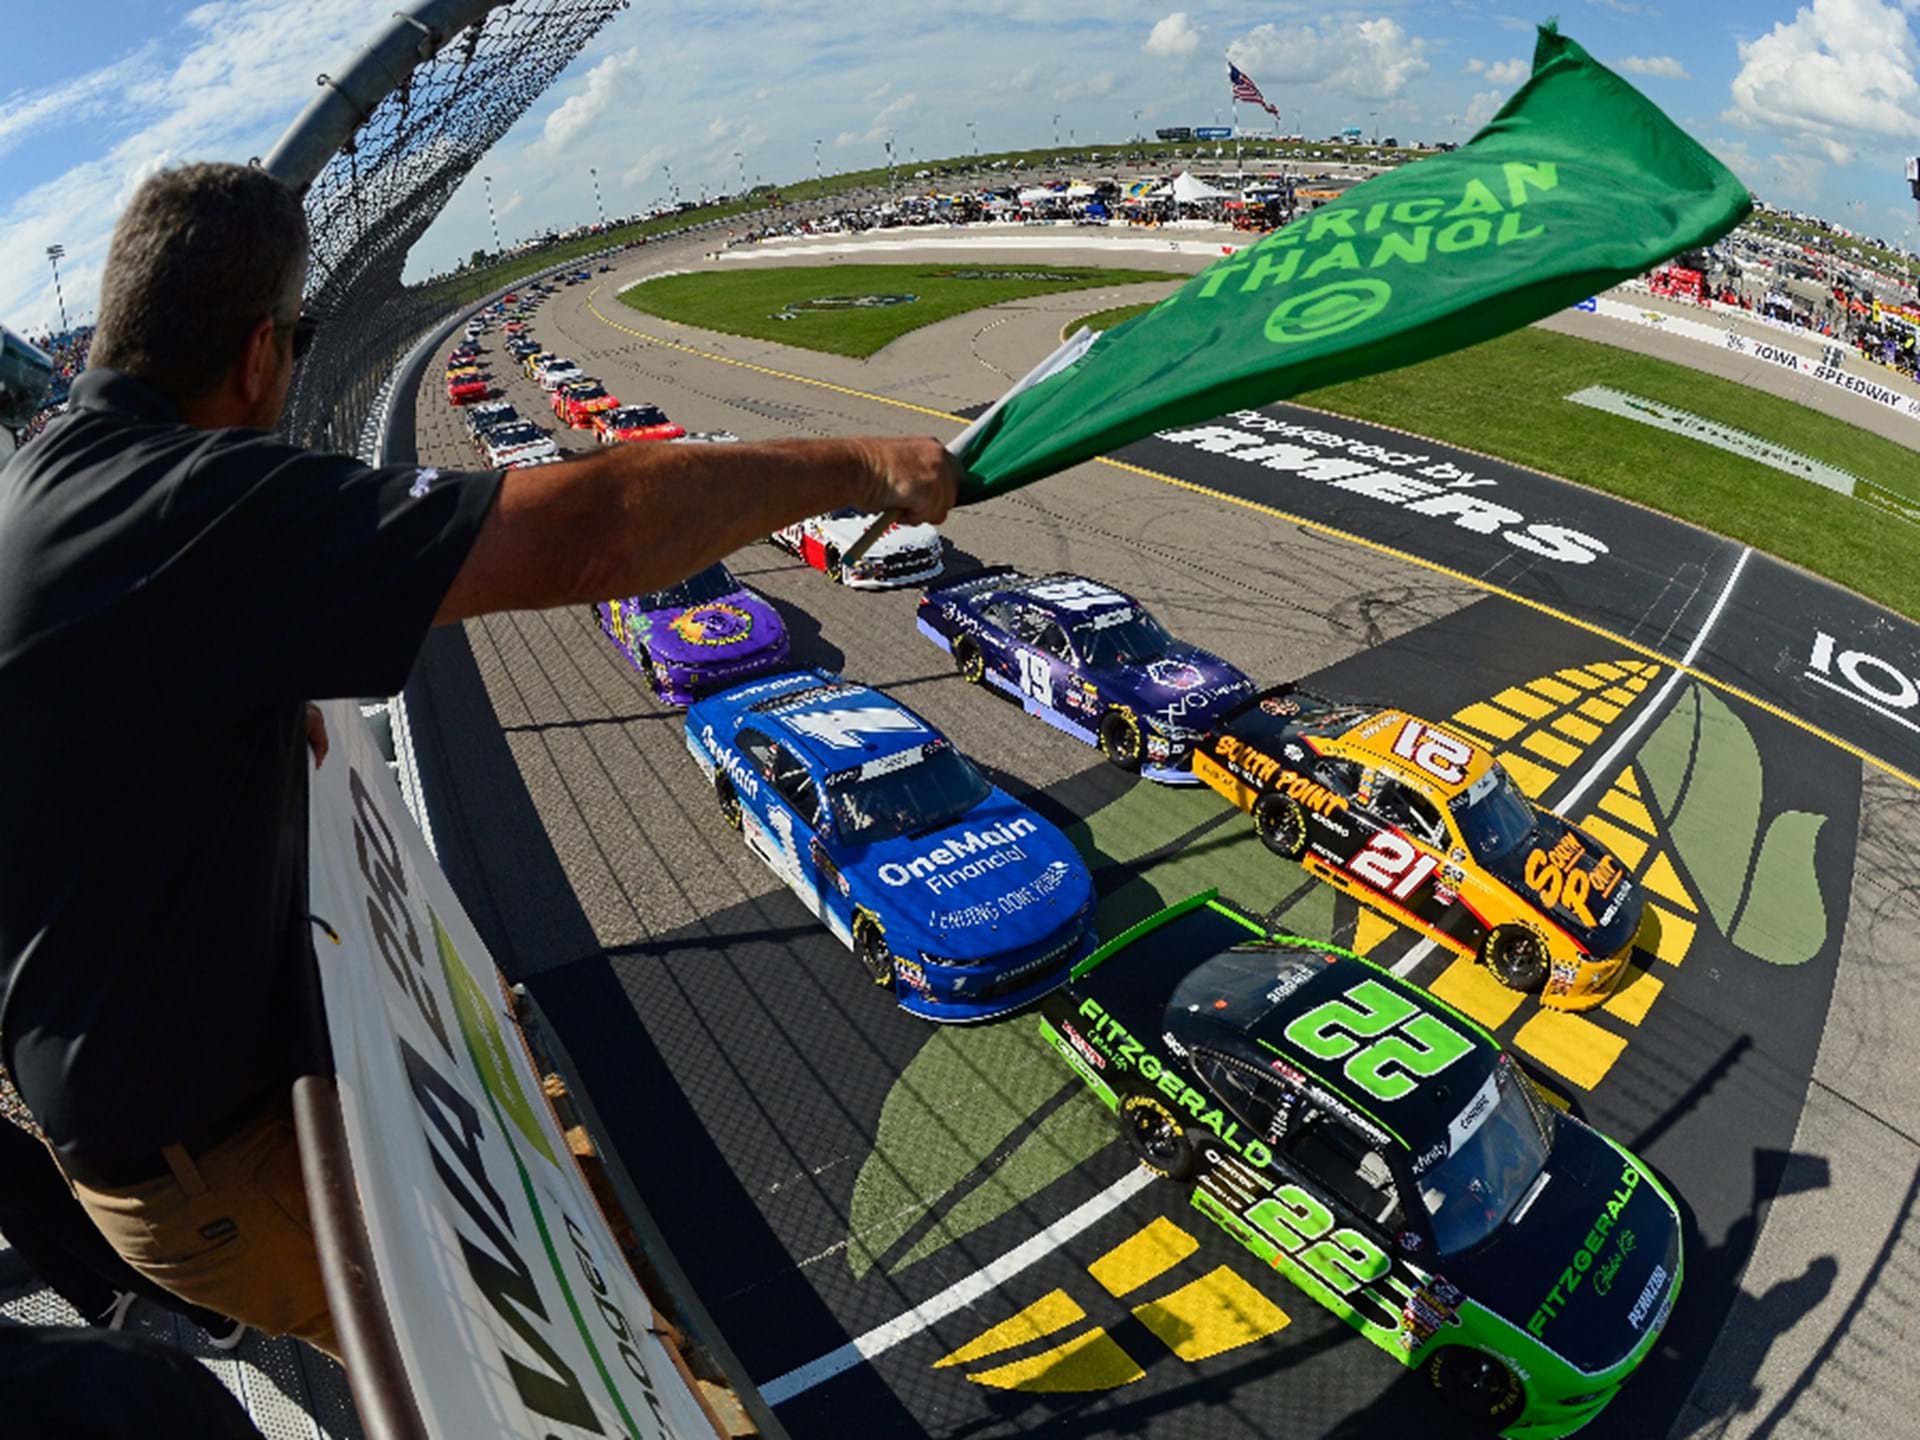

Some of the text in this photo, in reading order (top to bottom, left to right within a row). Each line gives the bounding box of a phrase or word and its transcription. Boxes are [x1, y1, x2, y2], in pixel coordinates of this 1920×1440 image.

[1236, 161, 1559, 256] ERICAN
[1186, 212, 1546, 300] THANOL
[1755, 342, 1901, 407] IOWA SPEEDWAY
[1226, 409, 1498, 488] powered by
[1154, 425, 1610, 564] RMERS
[1014, 647, 1053, 709] 19
[1809, 631, 1920, 710] IO
[701, 725, 759, 801] OneMain
[1215, 735, 1280, 782] SOUTH
[1276, 769, 1350, 818] POINT
[878, 817, 1038, 887] OneMain
[926, 844, 1028, 895] Financial
[1349, 827, 1441, 901] 21
[1078, 997, 1273, 1168] FITZGERALD
[1283, 978, 1478, 1102] 22
[398, 1034, 608, 1440] WA
[1242, 1183, 1393, 1297] 22
[1525, 1161, 1641, 1340] FITZGERALD
[562, 1212, 666, 1440] nogen
